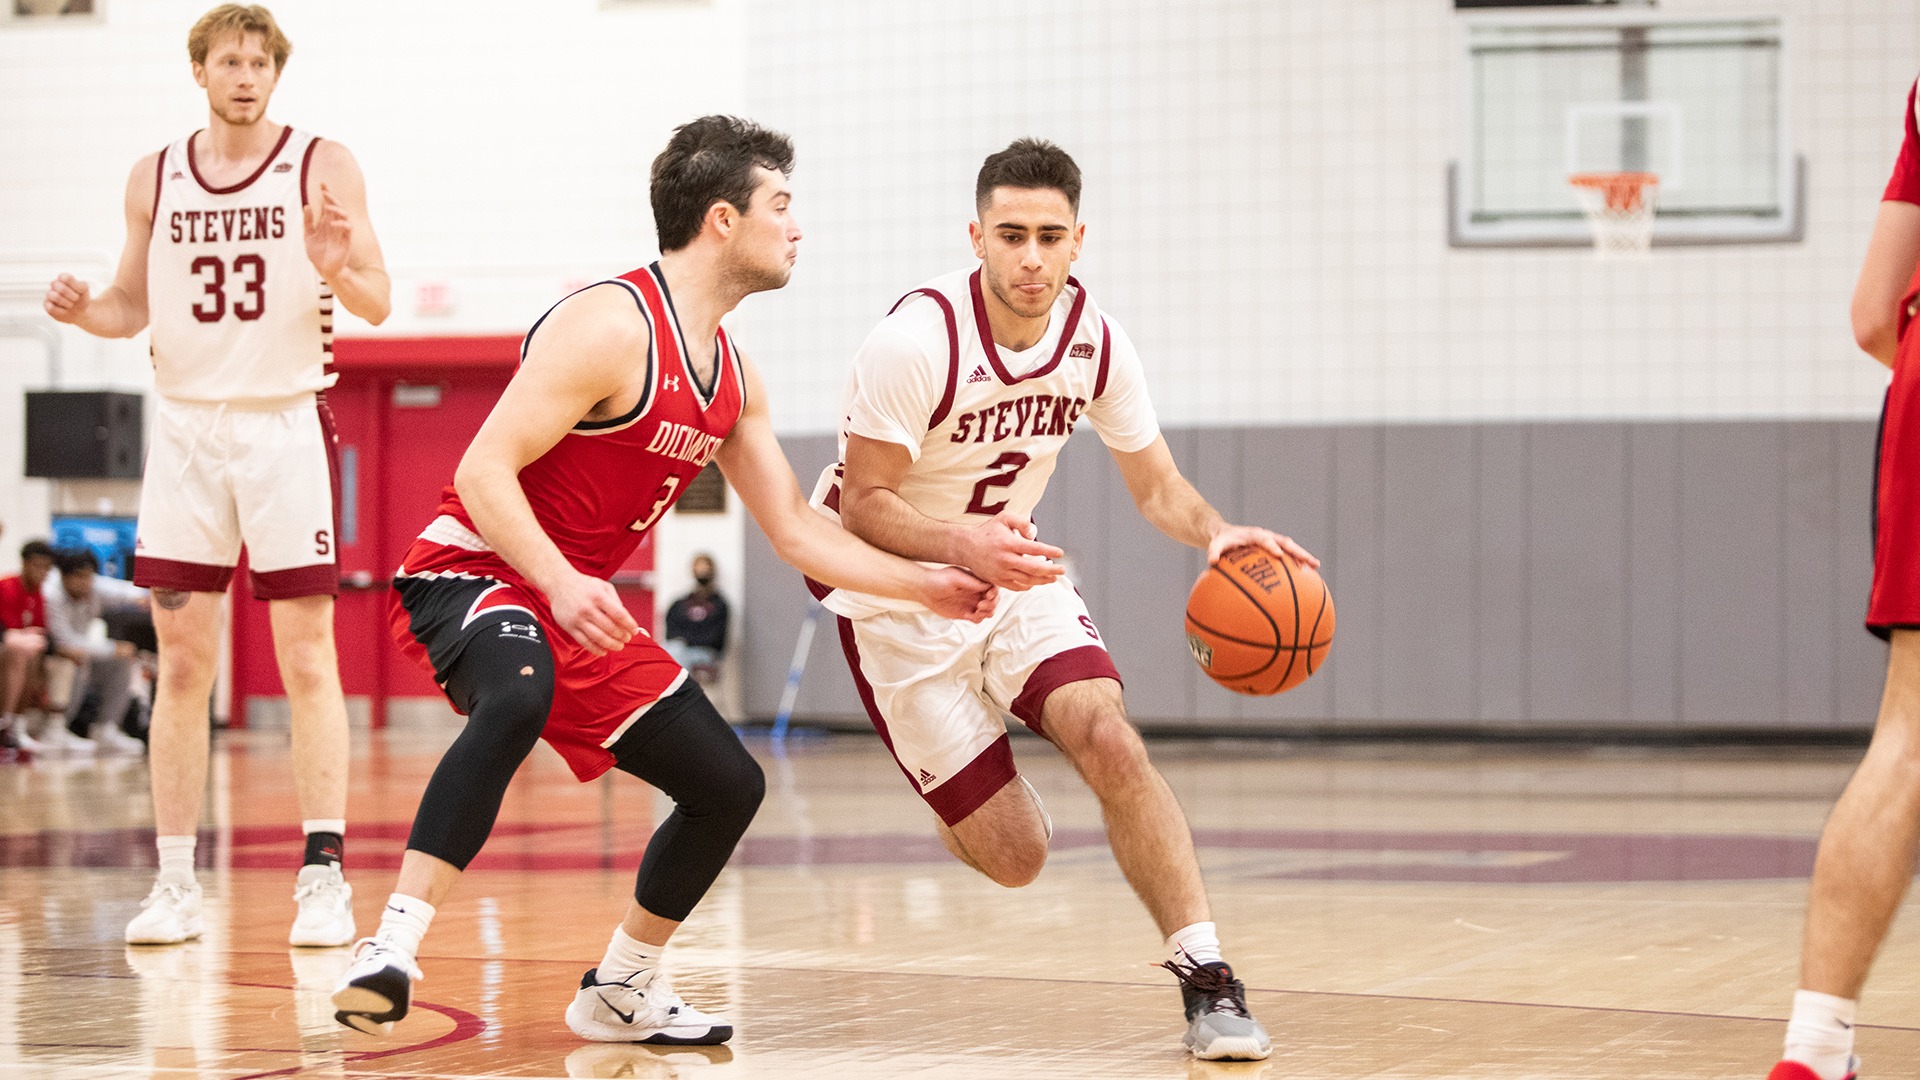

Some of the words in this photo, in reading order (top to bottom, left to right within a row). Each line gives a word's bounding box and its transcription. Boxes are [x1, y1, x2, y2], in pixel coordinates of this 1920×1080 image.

[170, 206, 285, 243] STEVENS
[191, 254, 265, 322] 33
[1070, 349, 1093, 359] MAC
[966, 375, 992, 384] adidas
[950, 394, 1087, 443] STEVENS
[964, 451, 1031, 516] 2
[627, 473, 680, 533] 3
[315, 530, 329, 555] S
[1239, 557, 1282, 595] THE
[1077, 615, 1099, 640] S
